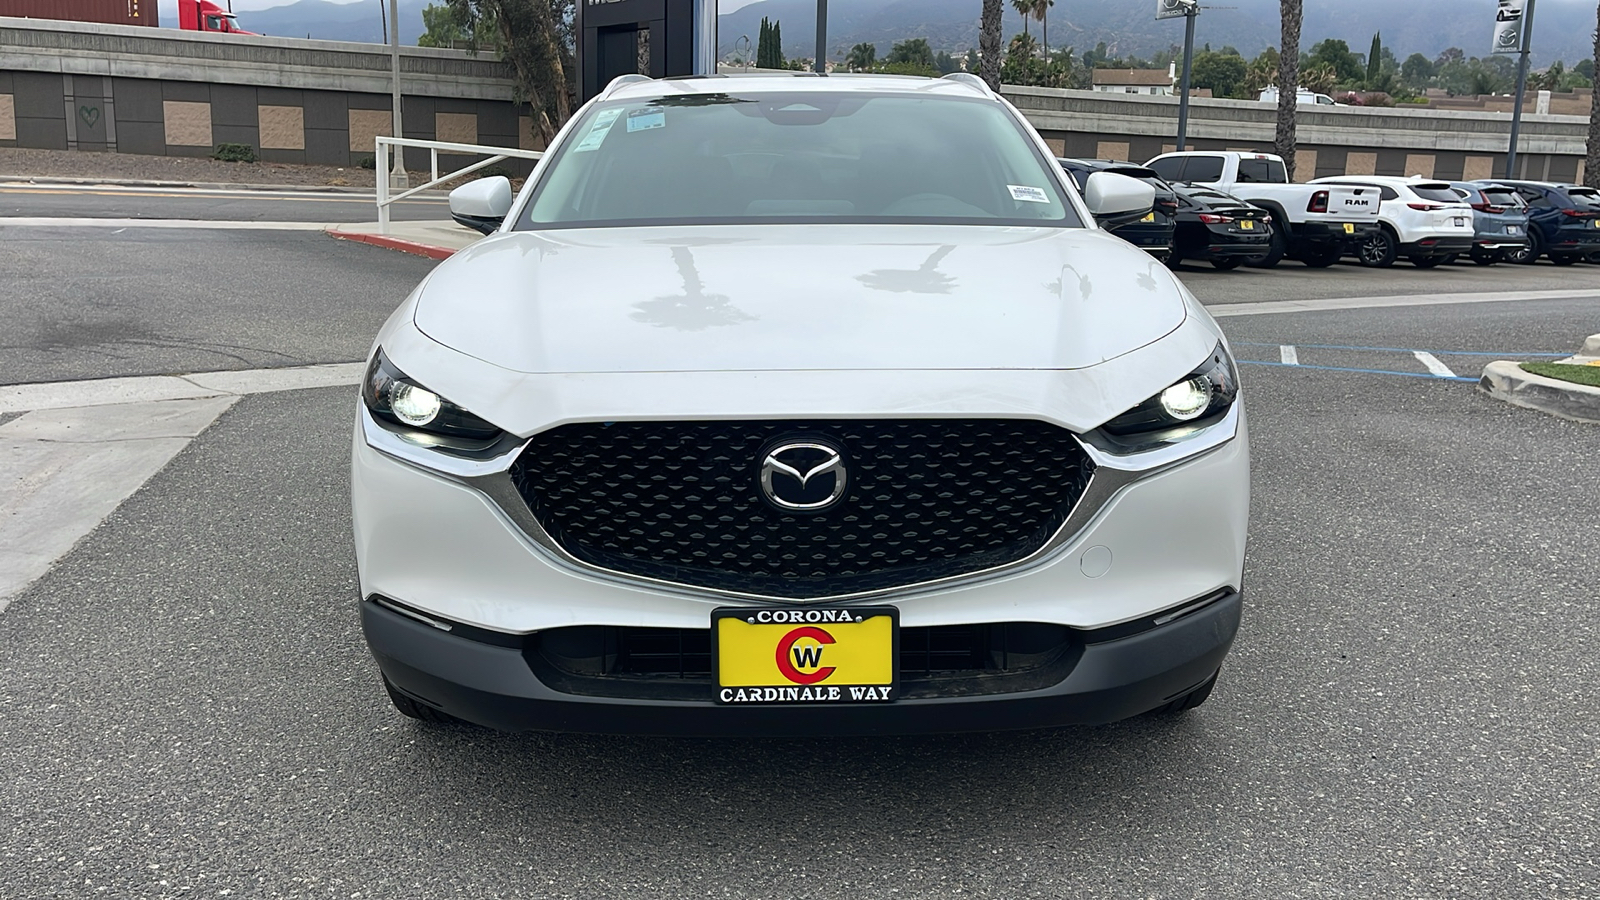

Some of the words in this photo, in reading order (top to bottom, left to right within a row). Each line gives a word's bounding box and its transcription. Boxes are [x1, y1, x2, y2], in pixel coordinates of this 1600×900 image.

[757, 610, 853, 623] CORONA
[720, 687, 841, 702] CARDINALE
[850, 686, 892, 700] WAY
